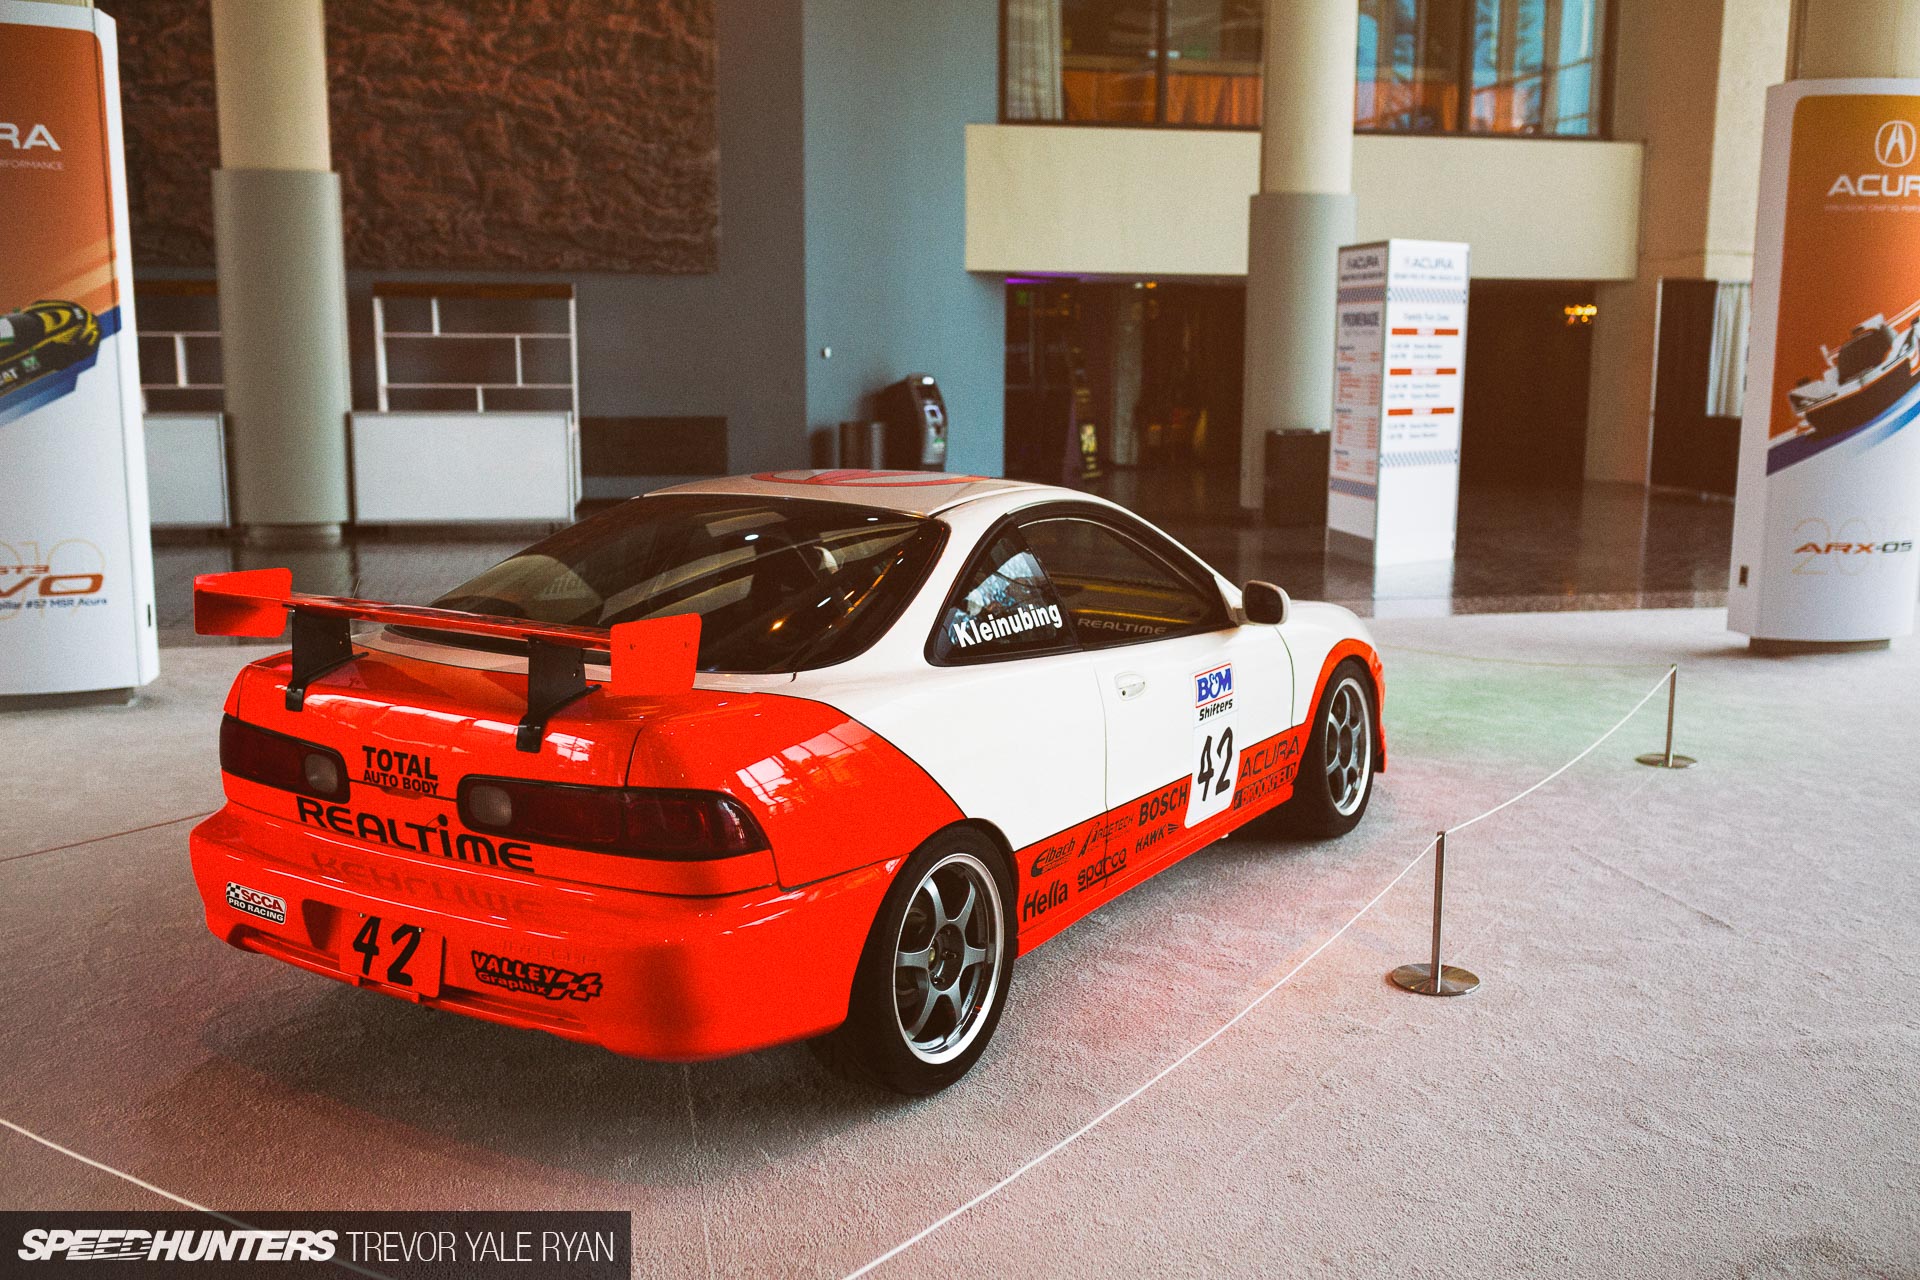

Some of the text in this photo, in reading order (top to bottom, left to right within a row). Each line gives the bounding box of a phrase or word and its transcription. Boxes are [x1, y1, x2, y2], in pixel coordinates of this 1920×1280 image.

[1793, 541, 1912, 555] ARX-05
[953, 603, 1064, 648] Kleinubing
[1078, 617, 1167, 636] REALTIME
[1197, 667, 1232, 703] B&M
[1199, 698, 1234, 722] Shifters
[362, 745, 439, 781] TOTAL
[1197, 726, 1234, 802] 42
[1238, 735, 1300, 784] ACURA
[363, 769, 439, 796] AUTO BODY
[1138, 783, 1189, 827] BOSCH
[1135, 823, 1168, 854] HAWK
[1077, 847, 1128, 891] sparco
[228, 896, 285, 923] PRO RACING
[240, 888, 284, 914] SCCA
[1023, 879, 1069, 923] Hella
[352, 915, 425, 987] 42
[471, 950, 556, 984] VALLEY
[475, 970, 548, 997] Graphix
